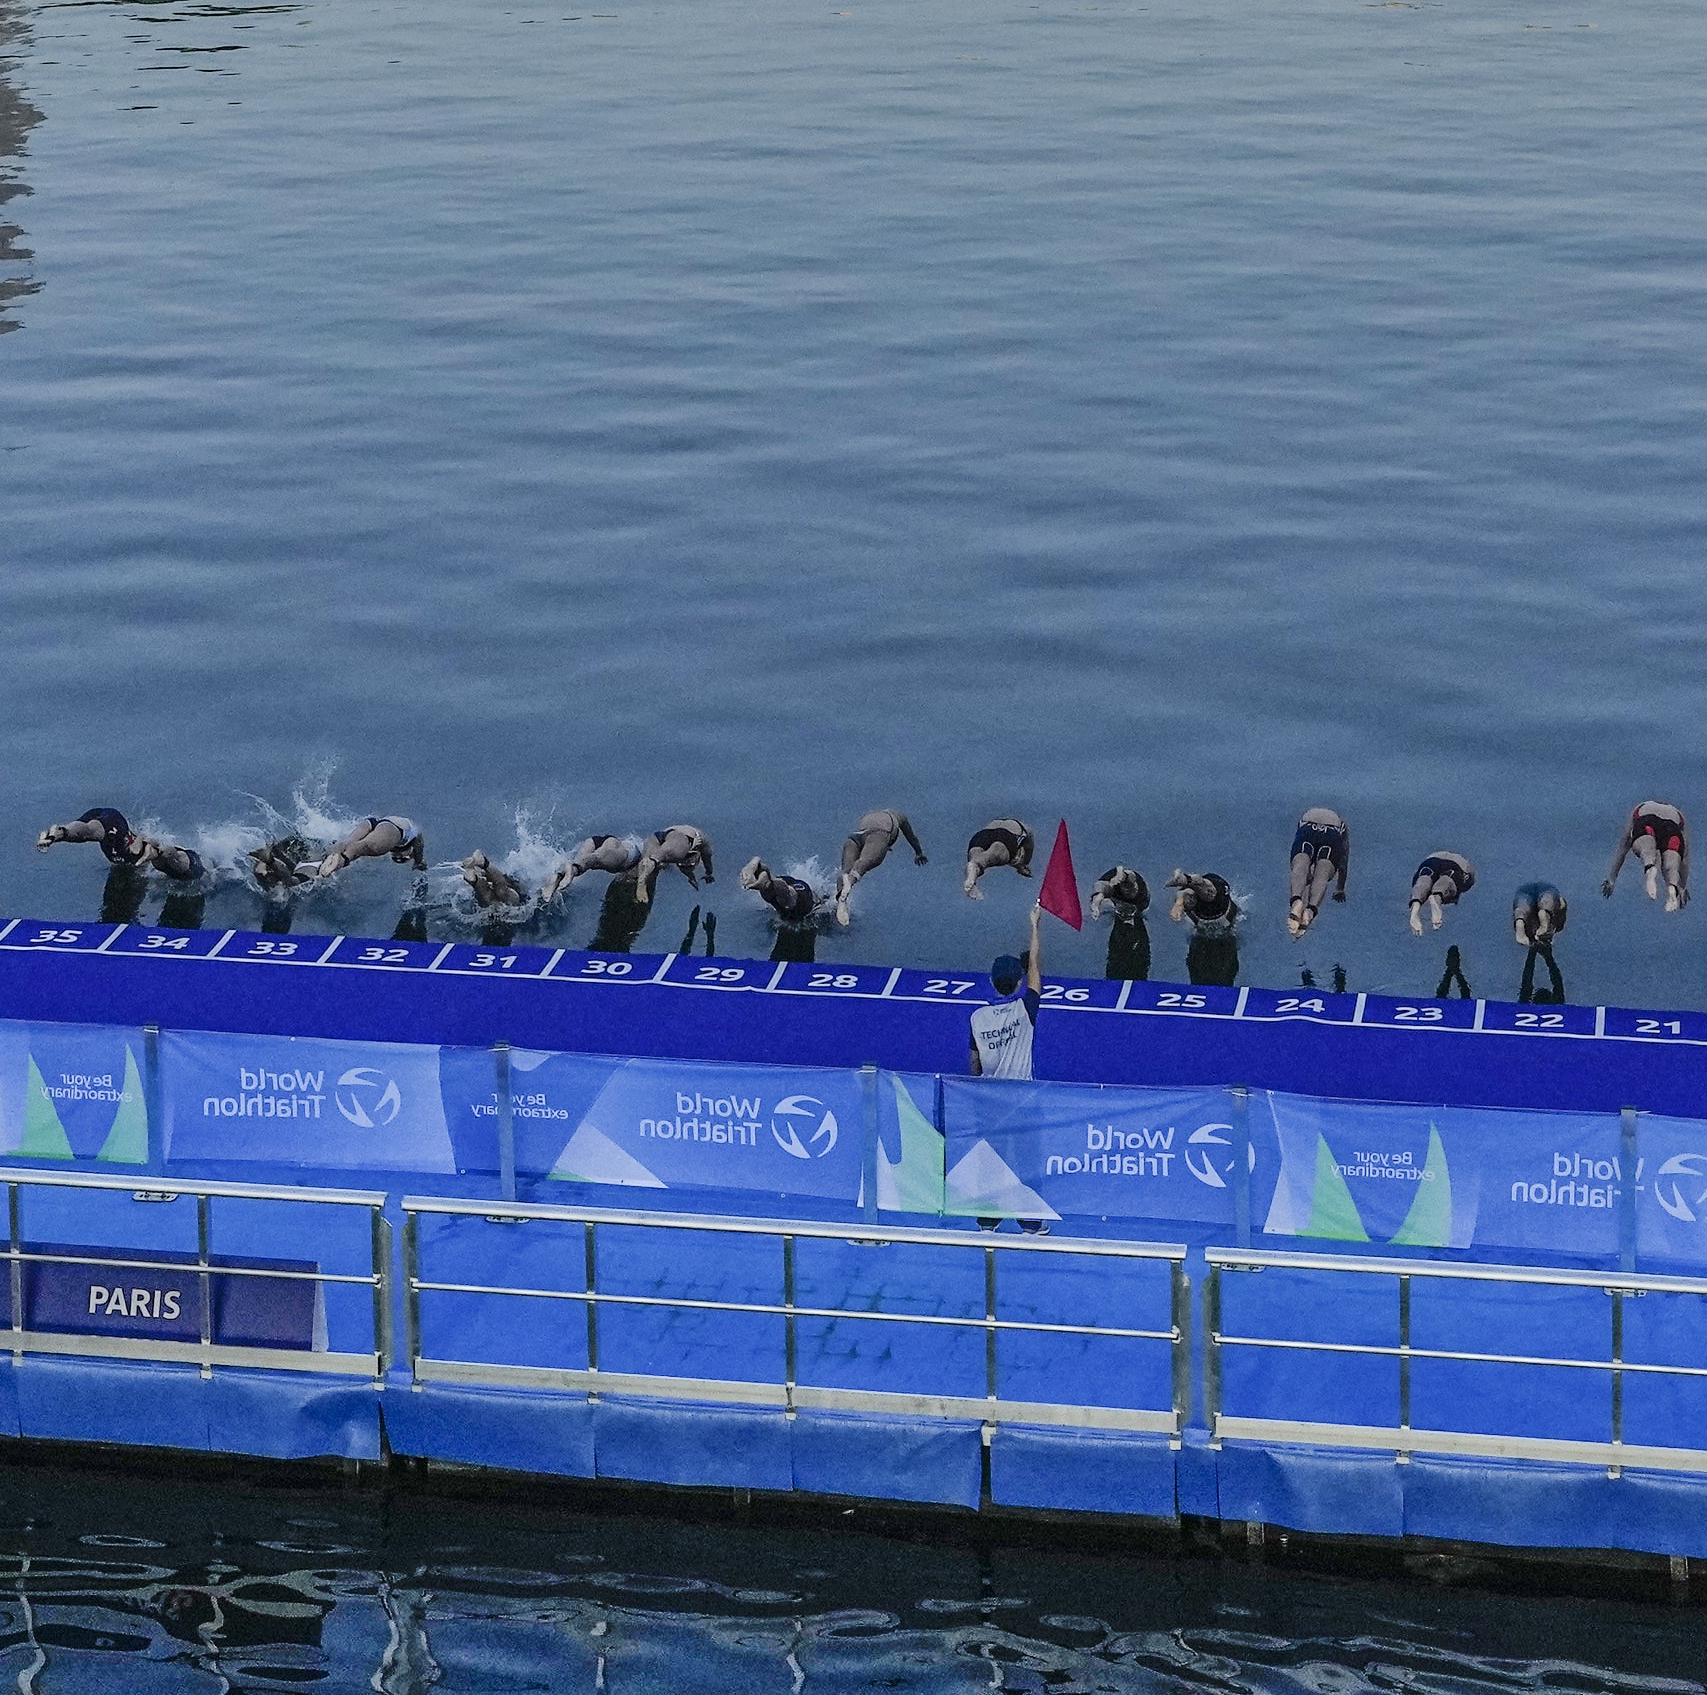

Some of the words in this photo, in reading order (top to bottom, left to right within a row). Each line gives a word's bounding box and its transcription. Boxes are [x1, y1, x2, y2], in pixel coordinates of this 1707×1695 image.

[32, 929, 83, 943] 35
[138, 935, 190, 950] 34
[247, 941, 299, 956] 33
[357, 947, 409, 963] 32
[468, 954, 518, 969] 31
[580, 960, 633, 975] 30
[694, 967, 745, 982] 29
[807, 973, 859, 988] 28
[922, 979, 976, 995] 27
[1039, 984, 1090, 1002] 26
[1156, 993, 1207, 1008] 25
[1275, 998, 1326, 1013] 24
[1394, 1006, 1443, 1021] 23
[1514, 1013, 1565, 1028] 22
[1635, 1019, 1681, 1034] 21
[88, 1285, 181, 1320] PARIS
